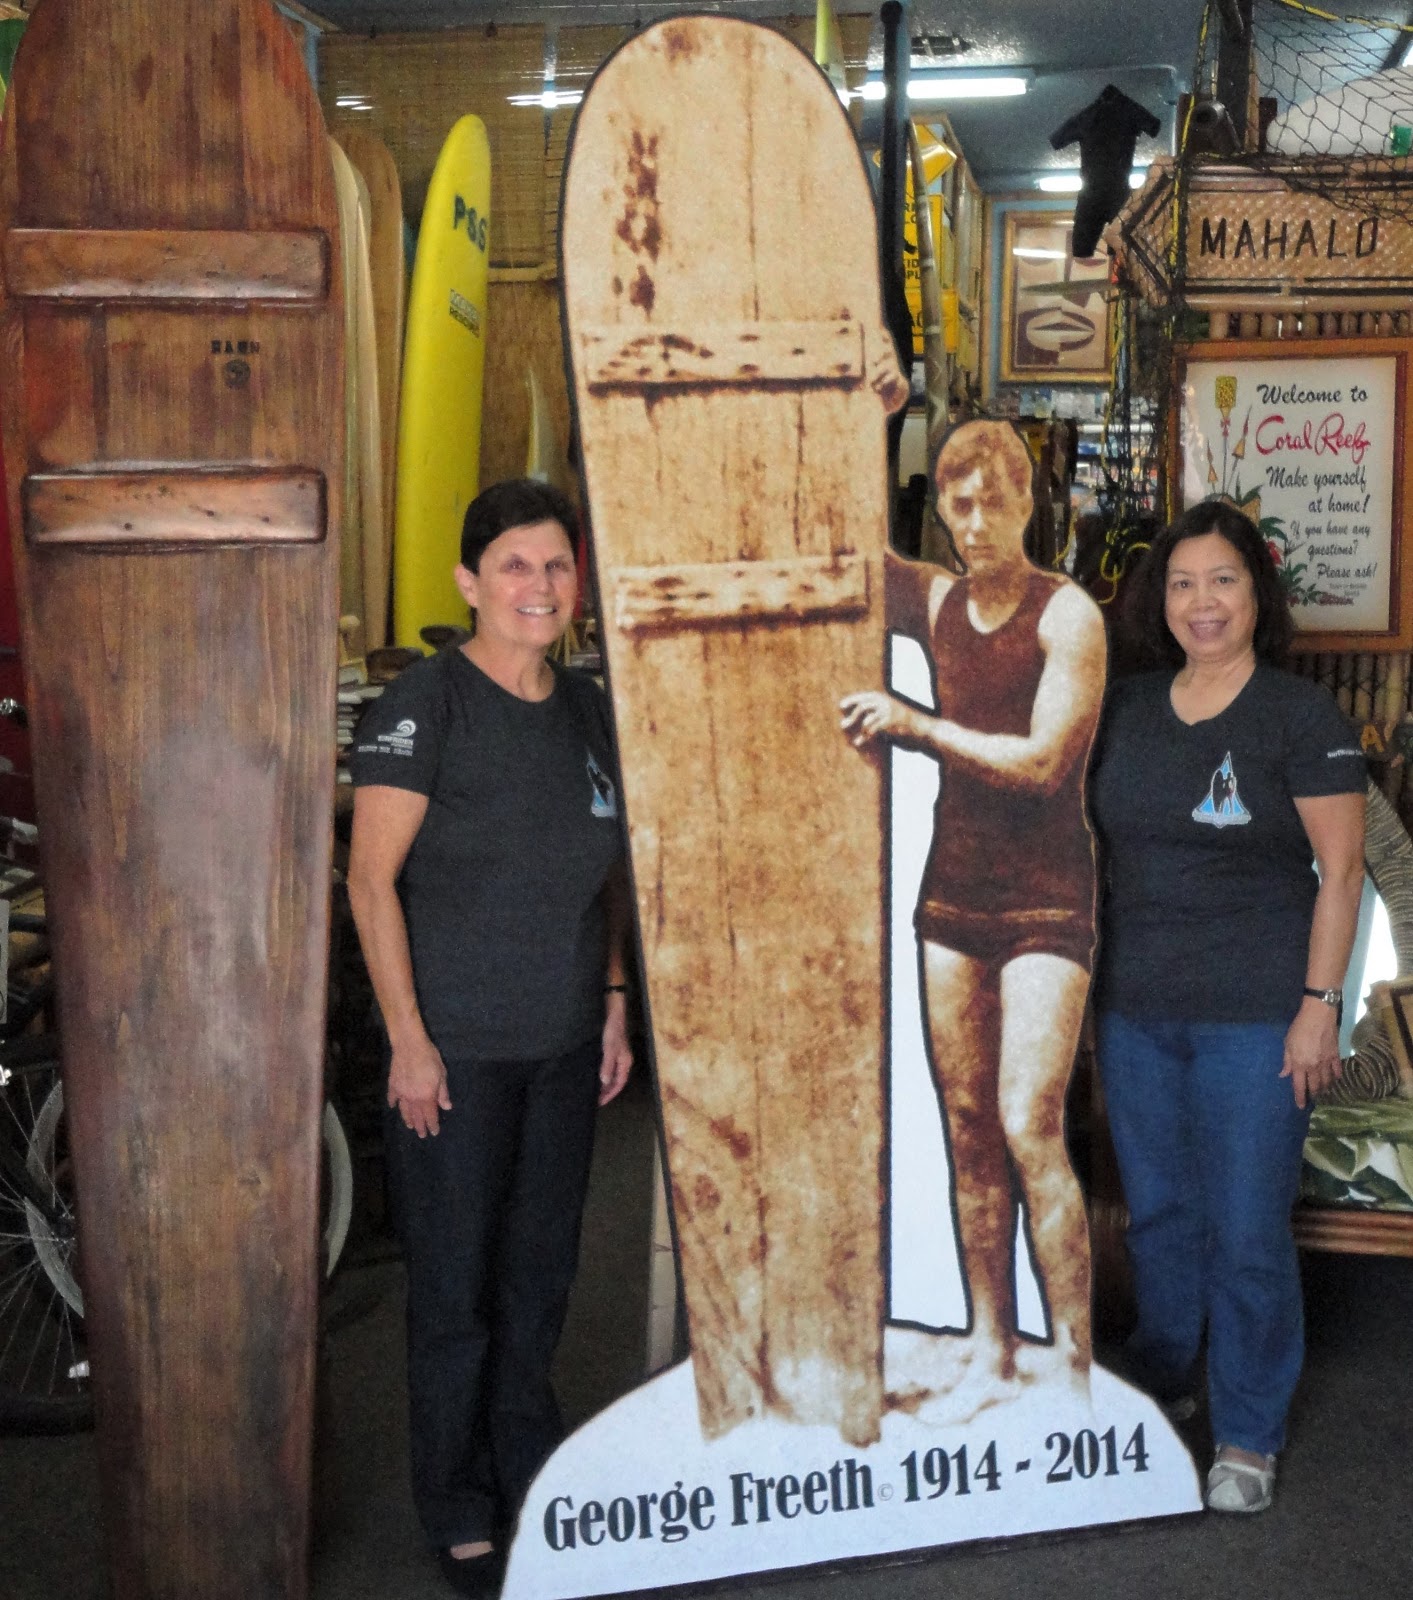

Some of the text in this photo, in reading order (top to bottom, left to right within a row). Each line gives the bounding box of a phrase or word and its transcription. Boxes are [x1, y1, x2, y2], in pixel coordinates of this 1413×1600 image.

[1200, 216, 1378, 260] MAHALO
[1256, 383, 1368, 404] Welcome to
[1256, 414, 1312, 455] Coral
[1265, 465, 1367, 493] Make yourself
[1308, 492, 1371, 514] at home!
[1305, 526, 1322, 539] you
[1326, 520, 1348, 535] have
[1352, 525, 1371, 538] any
[1307, 539, 1359, 562] questions?
[1316, 562, 1377, 579] Please ask!
[543, 1481, 716, 1551] George
[729, 1458, 876, 1526] Freeth
[900, 1440, 1002, 1503] 1914
[1045, 1422, 1150, 1484] 2014
